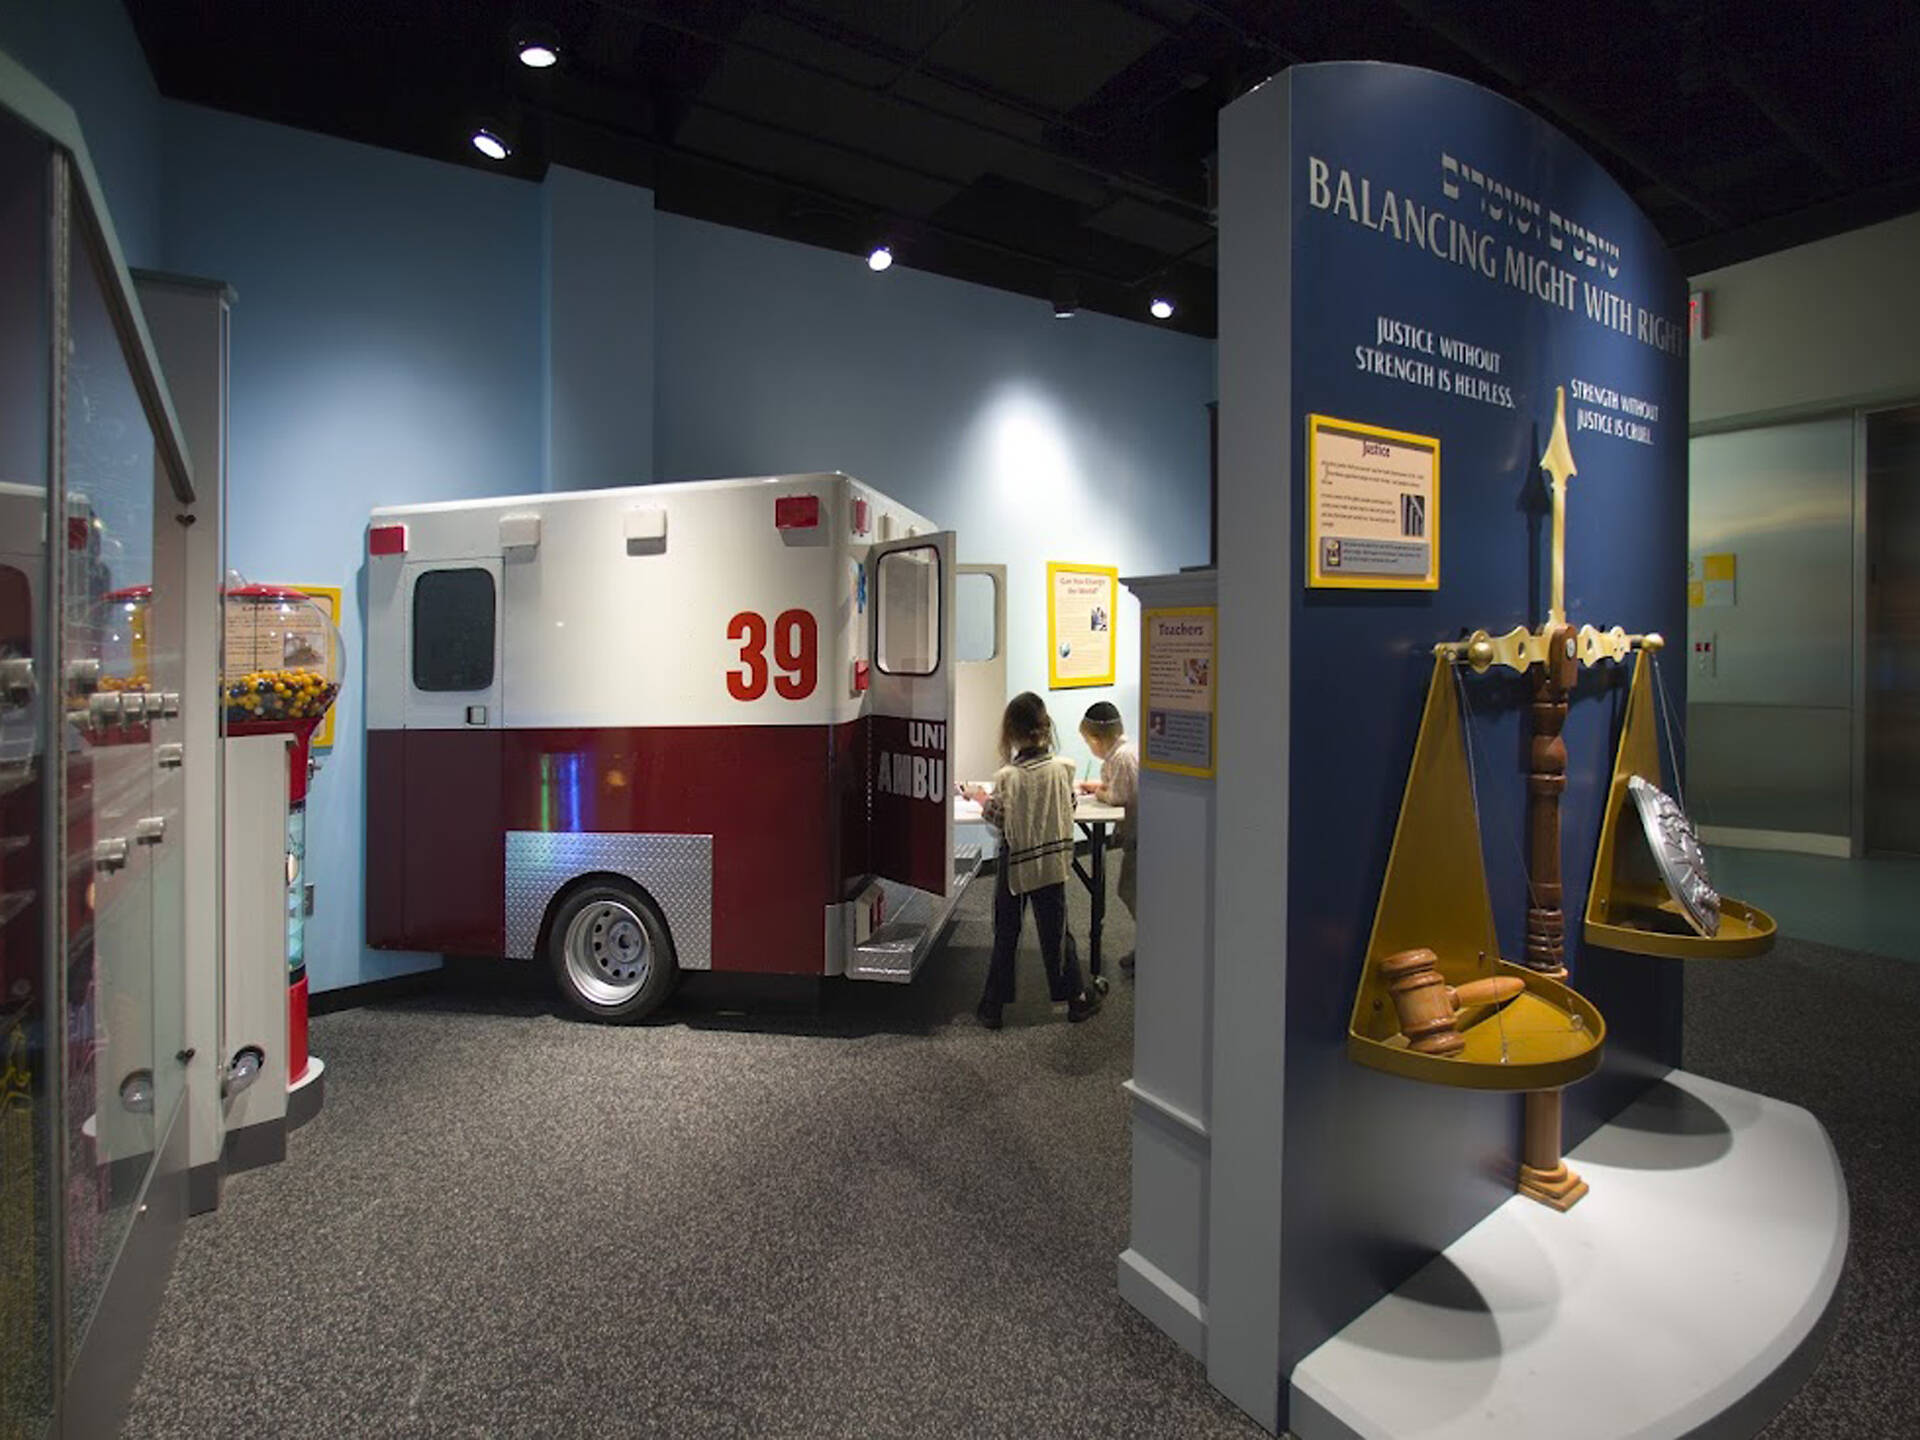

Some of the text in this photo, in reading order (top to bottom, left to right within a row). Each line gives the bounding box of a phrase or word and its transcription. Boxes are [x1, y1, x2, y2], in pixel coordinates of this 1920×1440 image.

[1309, 156, 1683, 358] BALANCING MIGHT WITH RIGHT
[1377, 316, 1500, 373] JUSTICE WITHOUT
[1355, 346, 1516, 409] STRENGTH IS HELPLESS.
[1571, 378, 1658, 422] STRENGTH WITHOUT
[1577, 408, 1612, 433] JUSTICE
[1614, 419, 1623, 437] IS
[1362, 440, 1391, 458] Justice
[1158, 623, 1204, 637] Teachers
[726, 609, 818, 702] 39
[908, 721, 945, 750] UNI
[878, 751, 944, 803] AMBU
